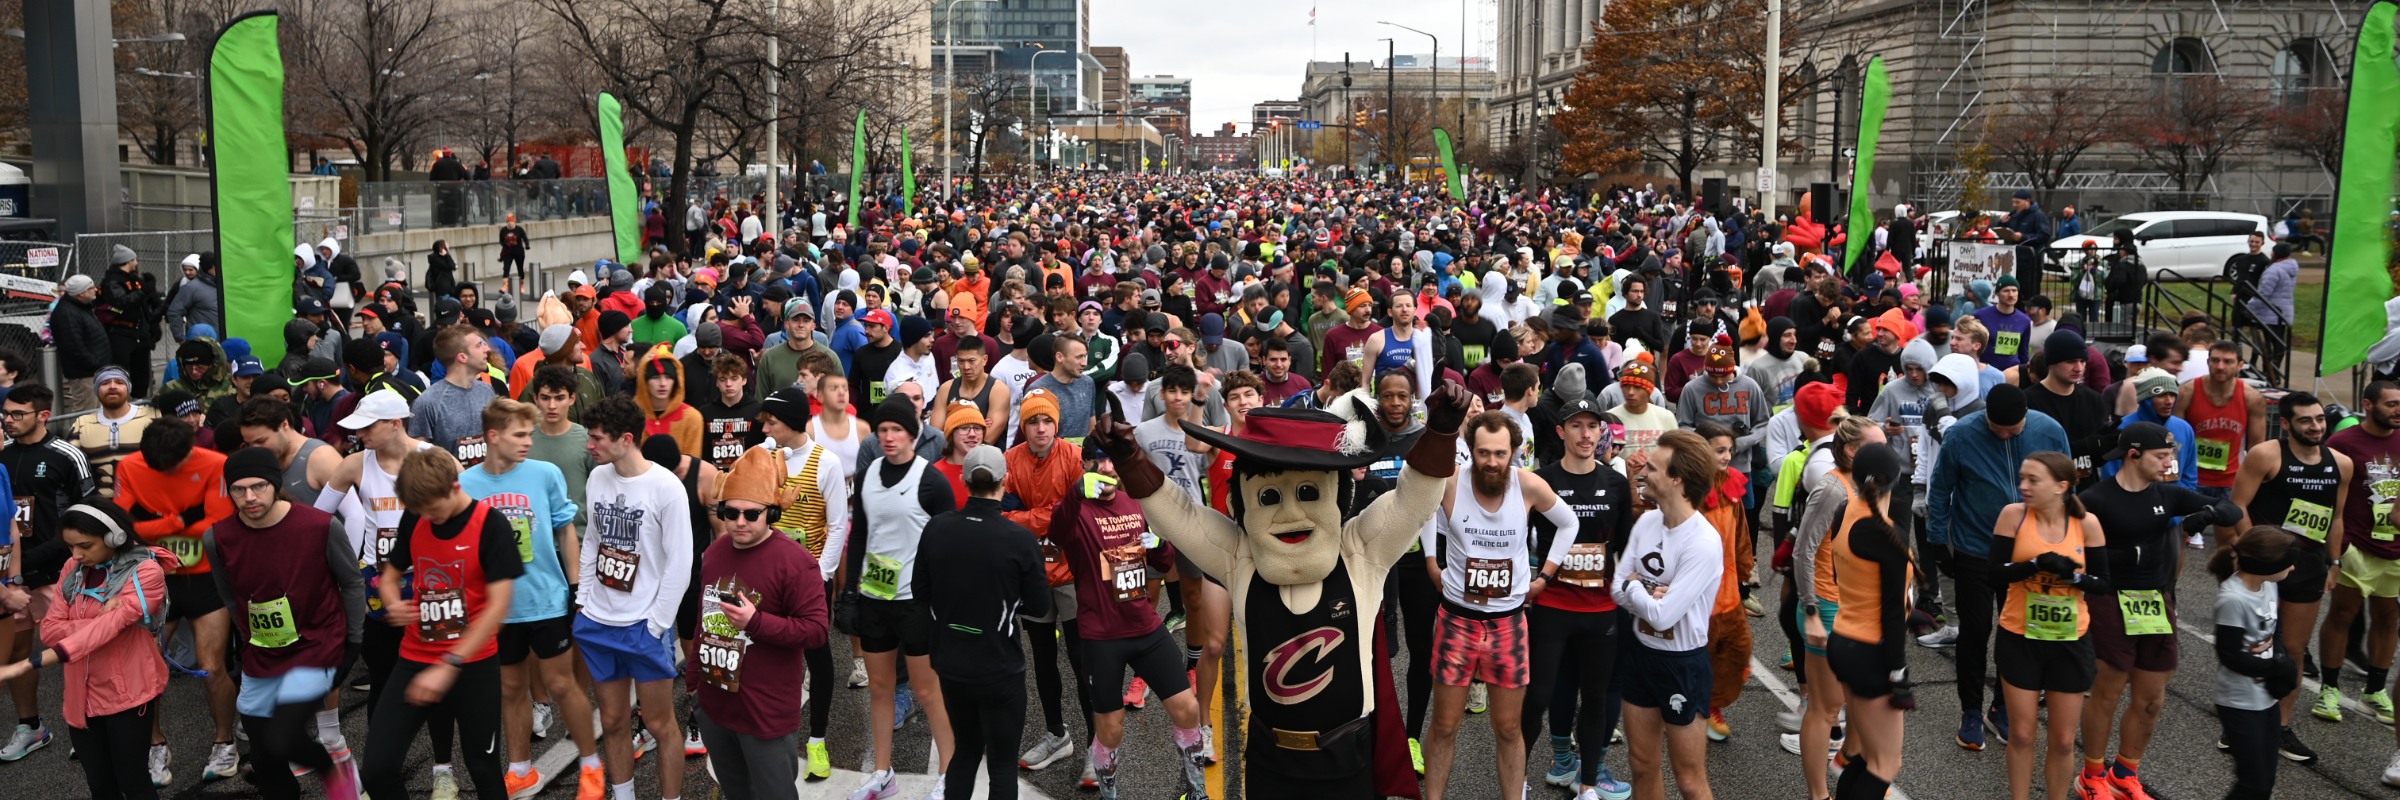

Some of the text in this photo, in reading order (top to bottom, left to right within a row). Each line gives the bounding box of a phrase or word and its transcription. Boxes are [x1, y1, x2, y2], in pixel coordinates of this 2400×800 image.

[28, 248, 57, 259] NATIONAL
[1954, 259, 1984, 273] Cleveland
[1998, 336, 2019, 346] 3219
[1703, 391, 1750, 416] CLE
[725, 421, 752, 432] COUNTRY
[458, 443, 487, 459] 8009
[713, 444, 743, 459] 6820
[1095, 513, 1142, 525] THE TOWPATH
[2288, 508, 2329, 532] 2309
[1101, 521, 1142, 533] MARATHON
[1478, 528, 1498, 536] LEAGUE
[598, 555, 636, 582] 8637
[1562, 553, 1605, 571] 9983
[1467, 568, 1510, 588] 7643
[420, 598, 465, 623] 8014
[1331, 610, 1350, 618] CLIFFS
[2028, 604, 2072, 623] 1562
[2124, 600, 2162, 616] 1423
[708, 626, 739, 639] TROT
[699, 643, 740, 671] 5108
